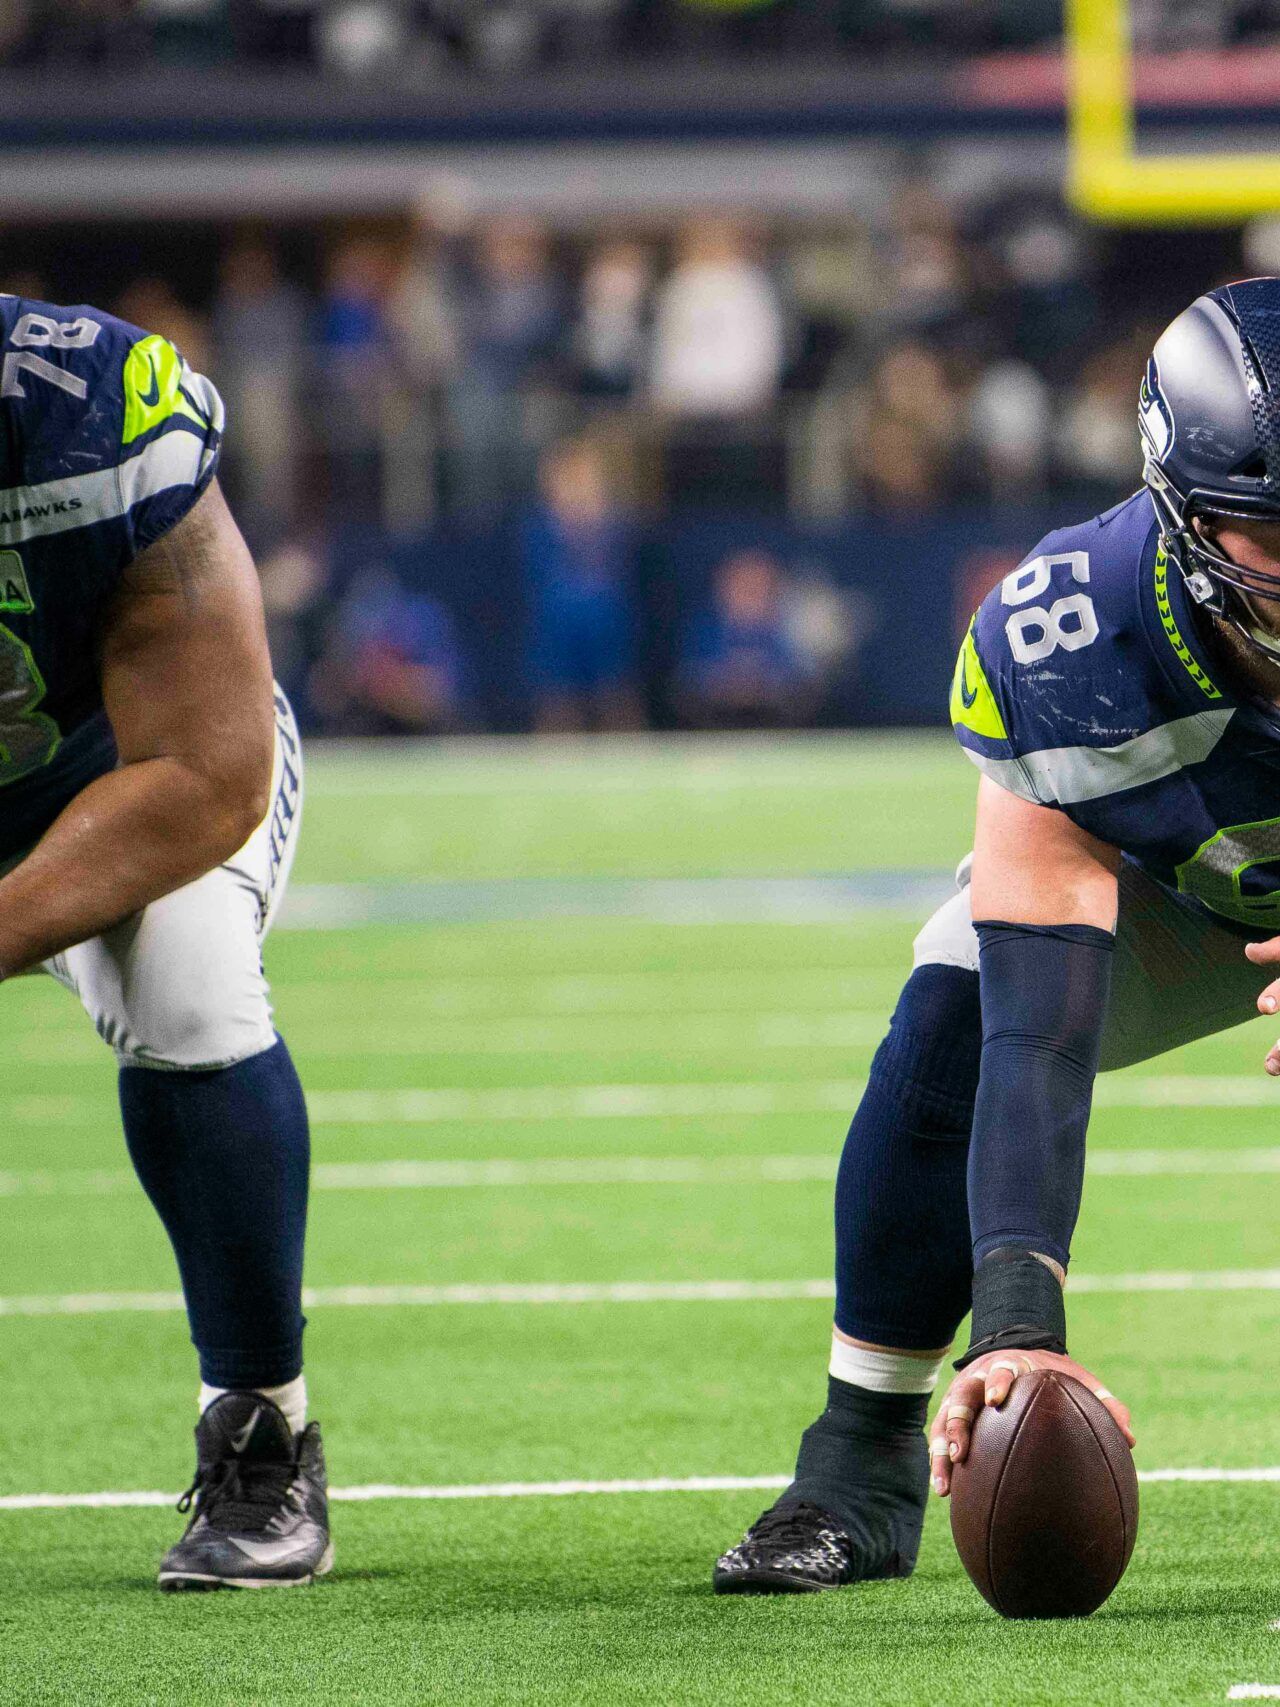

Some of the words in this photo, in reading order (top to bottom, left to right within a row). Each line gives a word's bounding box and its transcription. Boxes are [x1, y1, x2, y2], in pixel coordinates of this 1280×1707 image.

[2, 312, 101, 400] 78
[0, 579, 26, 602] A
[1001, 550, 1100, 665] 68
